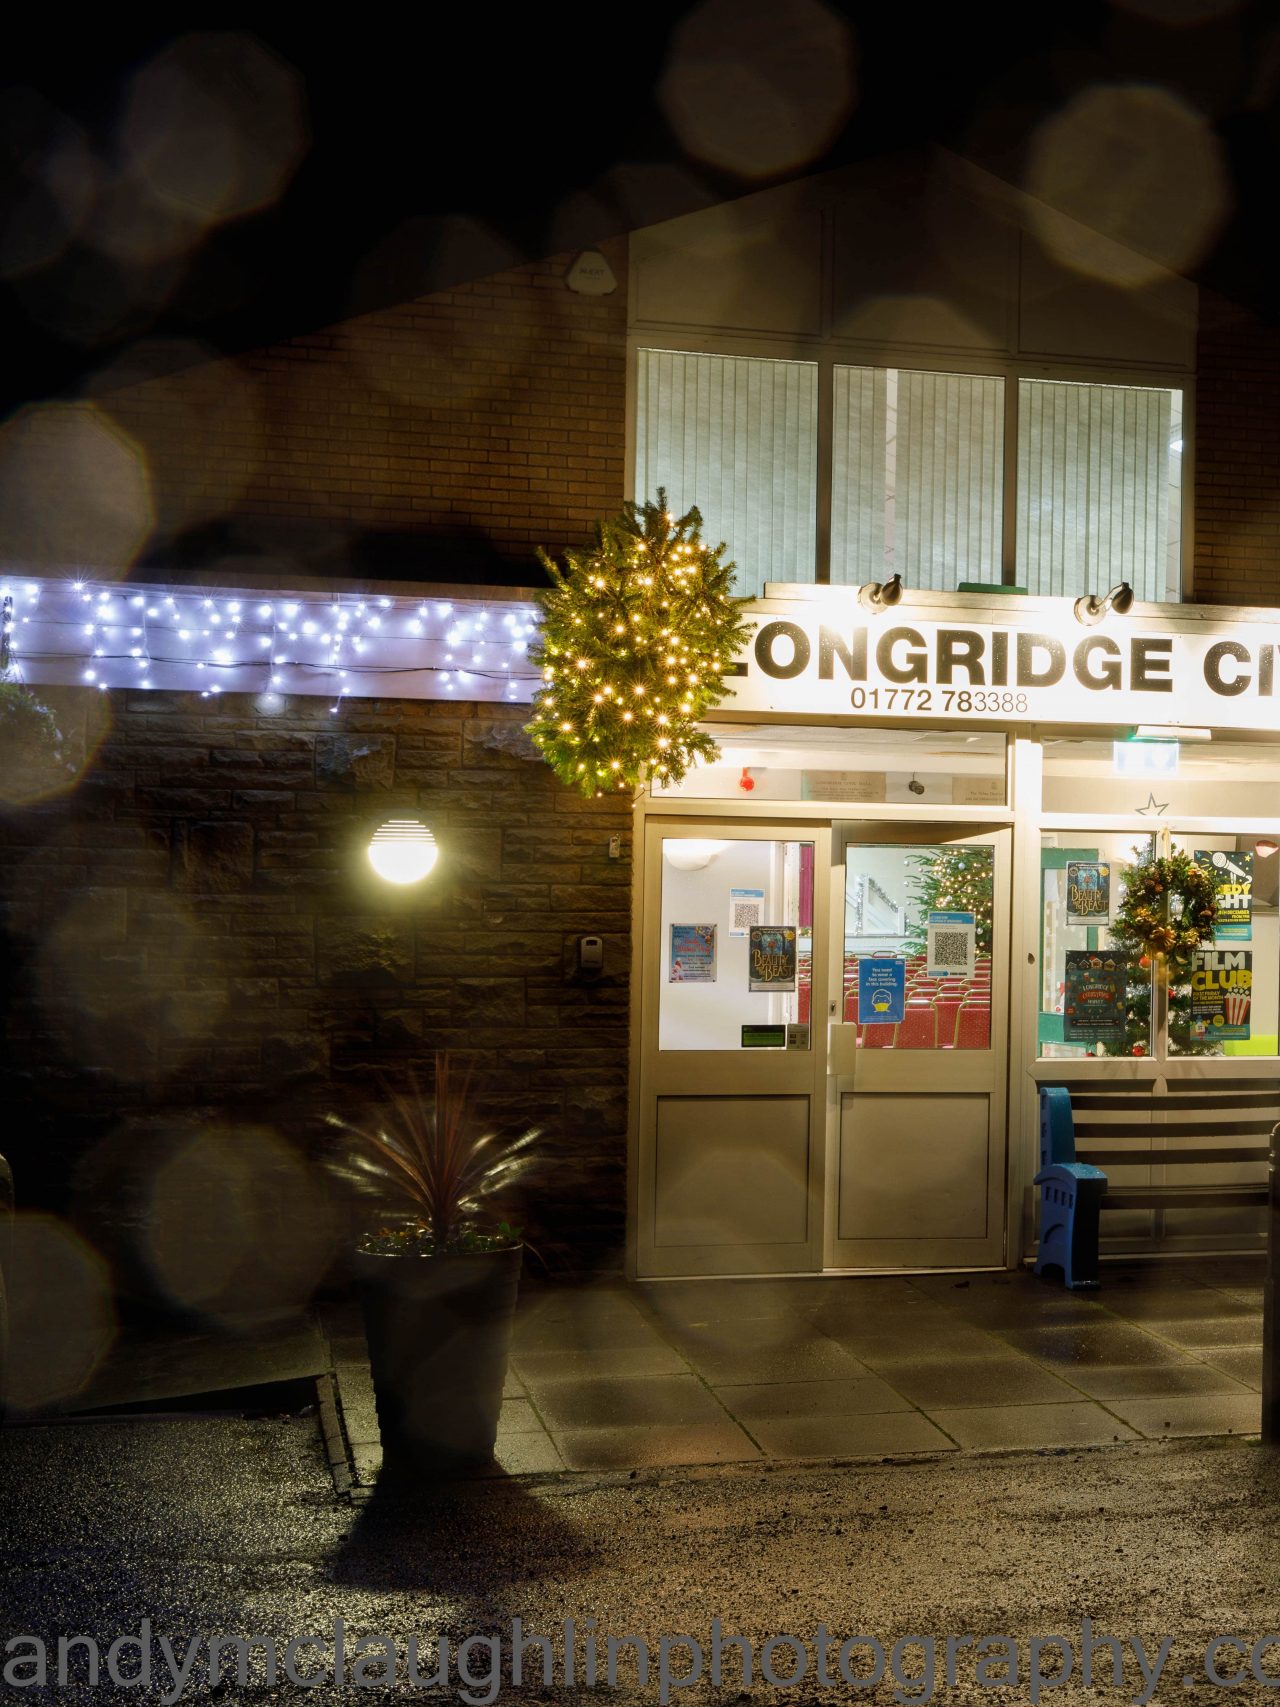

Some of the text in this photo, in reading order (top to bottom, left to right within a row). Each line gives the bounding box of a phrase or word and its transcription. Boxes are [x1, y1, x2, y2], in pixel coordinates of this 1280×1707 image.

[850, 686, 1028, 713] 01772 783388
[1070, 884, 1104, 901] BEAUTY
[1080, 899, 1109, 916] BEAST
[752, 949, 790, 967] BEAUTY
[1192, 951, 1246, 971] FILM
[764, 965, 794, 982] BEAST
[1191, 970, 1252, 991] CLUB
